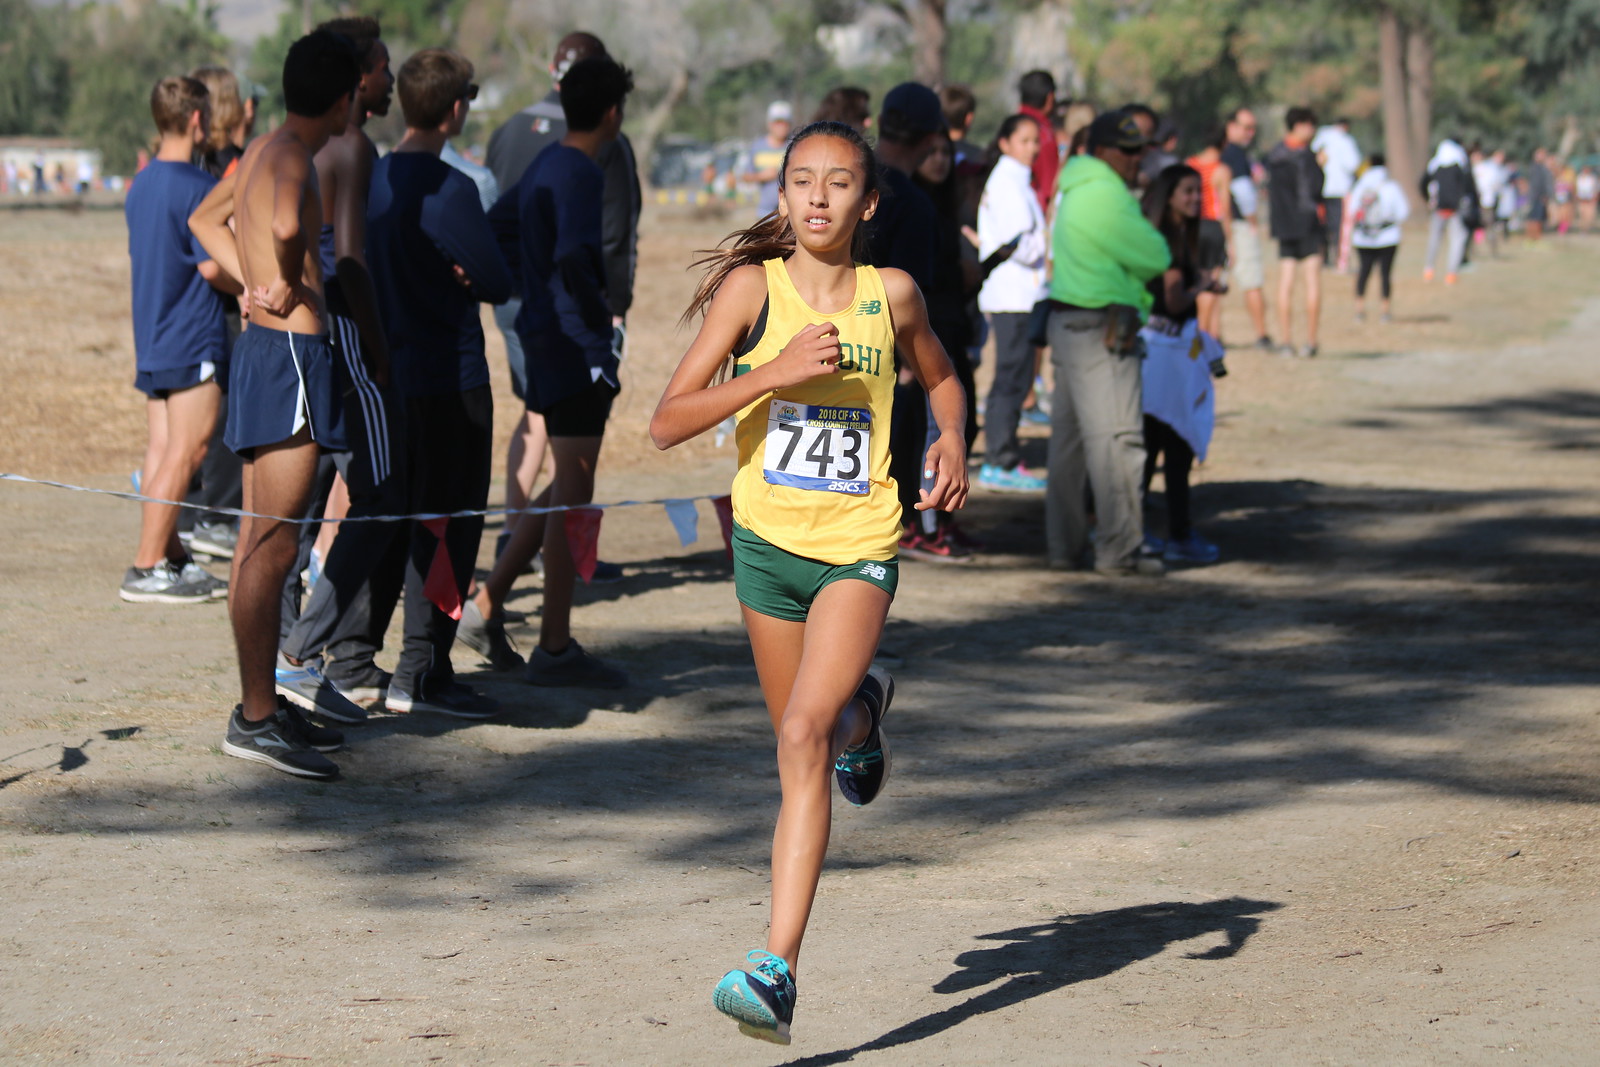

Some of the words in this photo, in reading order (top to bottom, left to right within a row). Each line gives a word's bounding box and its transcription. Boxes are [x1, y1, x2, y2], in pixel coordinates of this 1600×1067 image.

[818, 408, 837, 420] 2018
[806, 419, 825, 428] CROSS
[825, 420, 849, 430] COUNTRY
[849, 421, 869, 431] PRELIMS
[776, 422, 862, 480] 743
